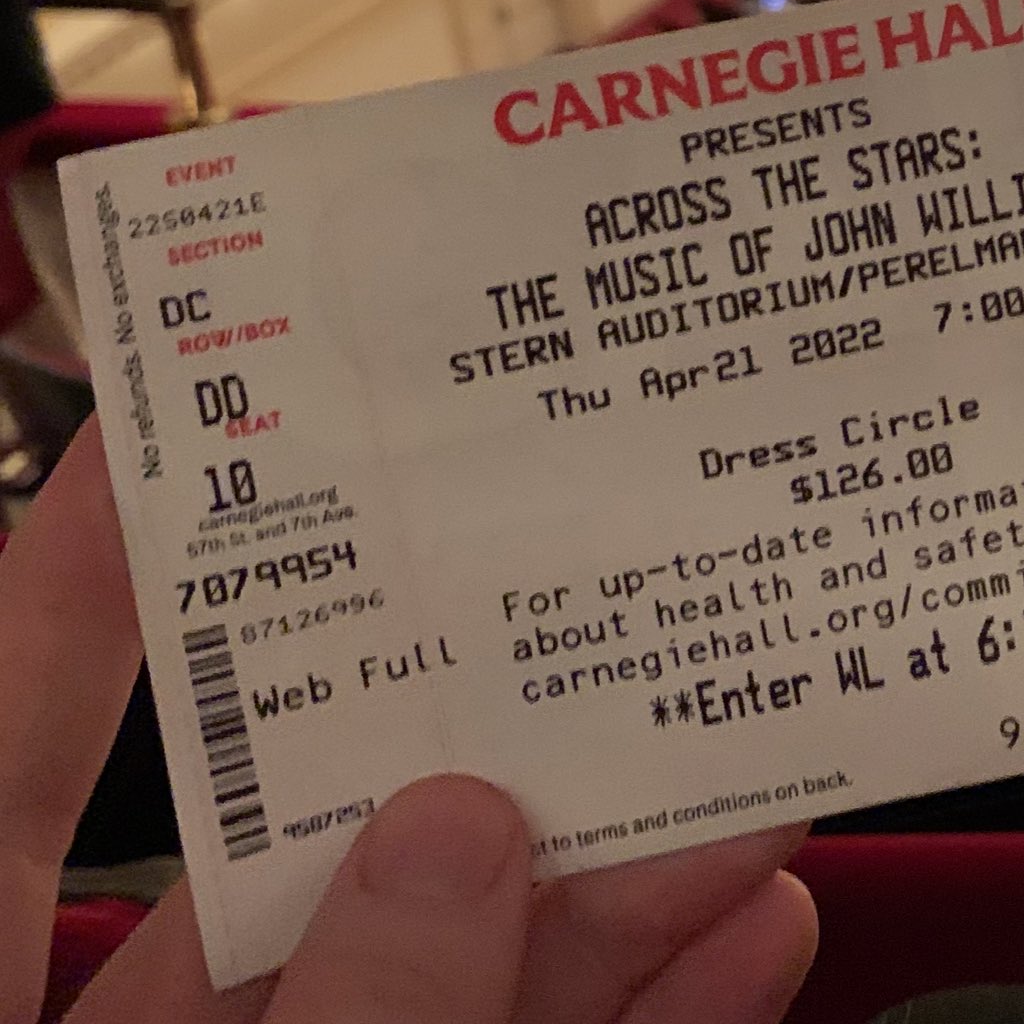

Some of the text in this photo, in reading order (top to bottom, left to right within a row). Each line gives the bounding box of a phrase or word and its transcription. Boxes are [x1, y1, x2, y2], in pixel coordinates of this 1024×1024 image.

[493, 25, 866, 146] CARNEGIE
[679, 97, 872, 164] PRESENTS
[165, 155, 235, 187] EVENT
[584, 126, 982, 248] ACROSS THE STARS:
[167, 230, 264, 267] SECTION
[485, 273, 565, 331] THE
[584, 242, 708, 310] MUSIC
[728, 225, 774, 277] OF
[804, 200, 898, 262] JOHN
[158, 289, 212, 329] DC
[449, 329, 575, 385] STERN
[536, 386, 611, 421] Thu
[789, 318, 885, 366] 2022
[194, 373, 249, 428] DD
[698, 395, 980, 480] Dress Circle
[790, 441, 954, 504] $126.00
[203, 458, 258, 514] 10
[176, 540, 357, 614] 7079954
[501, 586, 570, 622] For
[598, 526, 832, 601] up-to-date
[513, 610, 628, 662] about
[654, 572, 793, 629] health
[820, 547, 888, 592] and
[252, 636, 457, 721] Web Full
[834, 645, 885, 695] WL
[907, 629, 950, 681] at
[551, 835, 572, 853] to
[575, 822, 629, 848] terms
[632, 809, 668, 835] and
[672, 789, 772, 825] conditions
[774, 782, 800, 801] on
